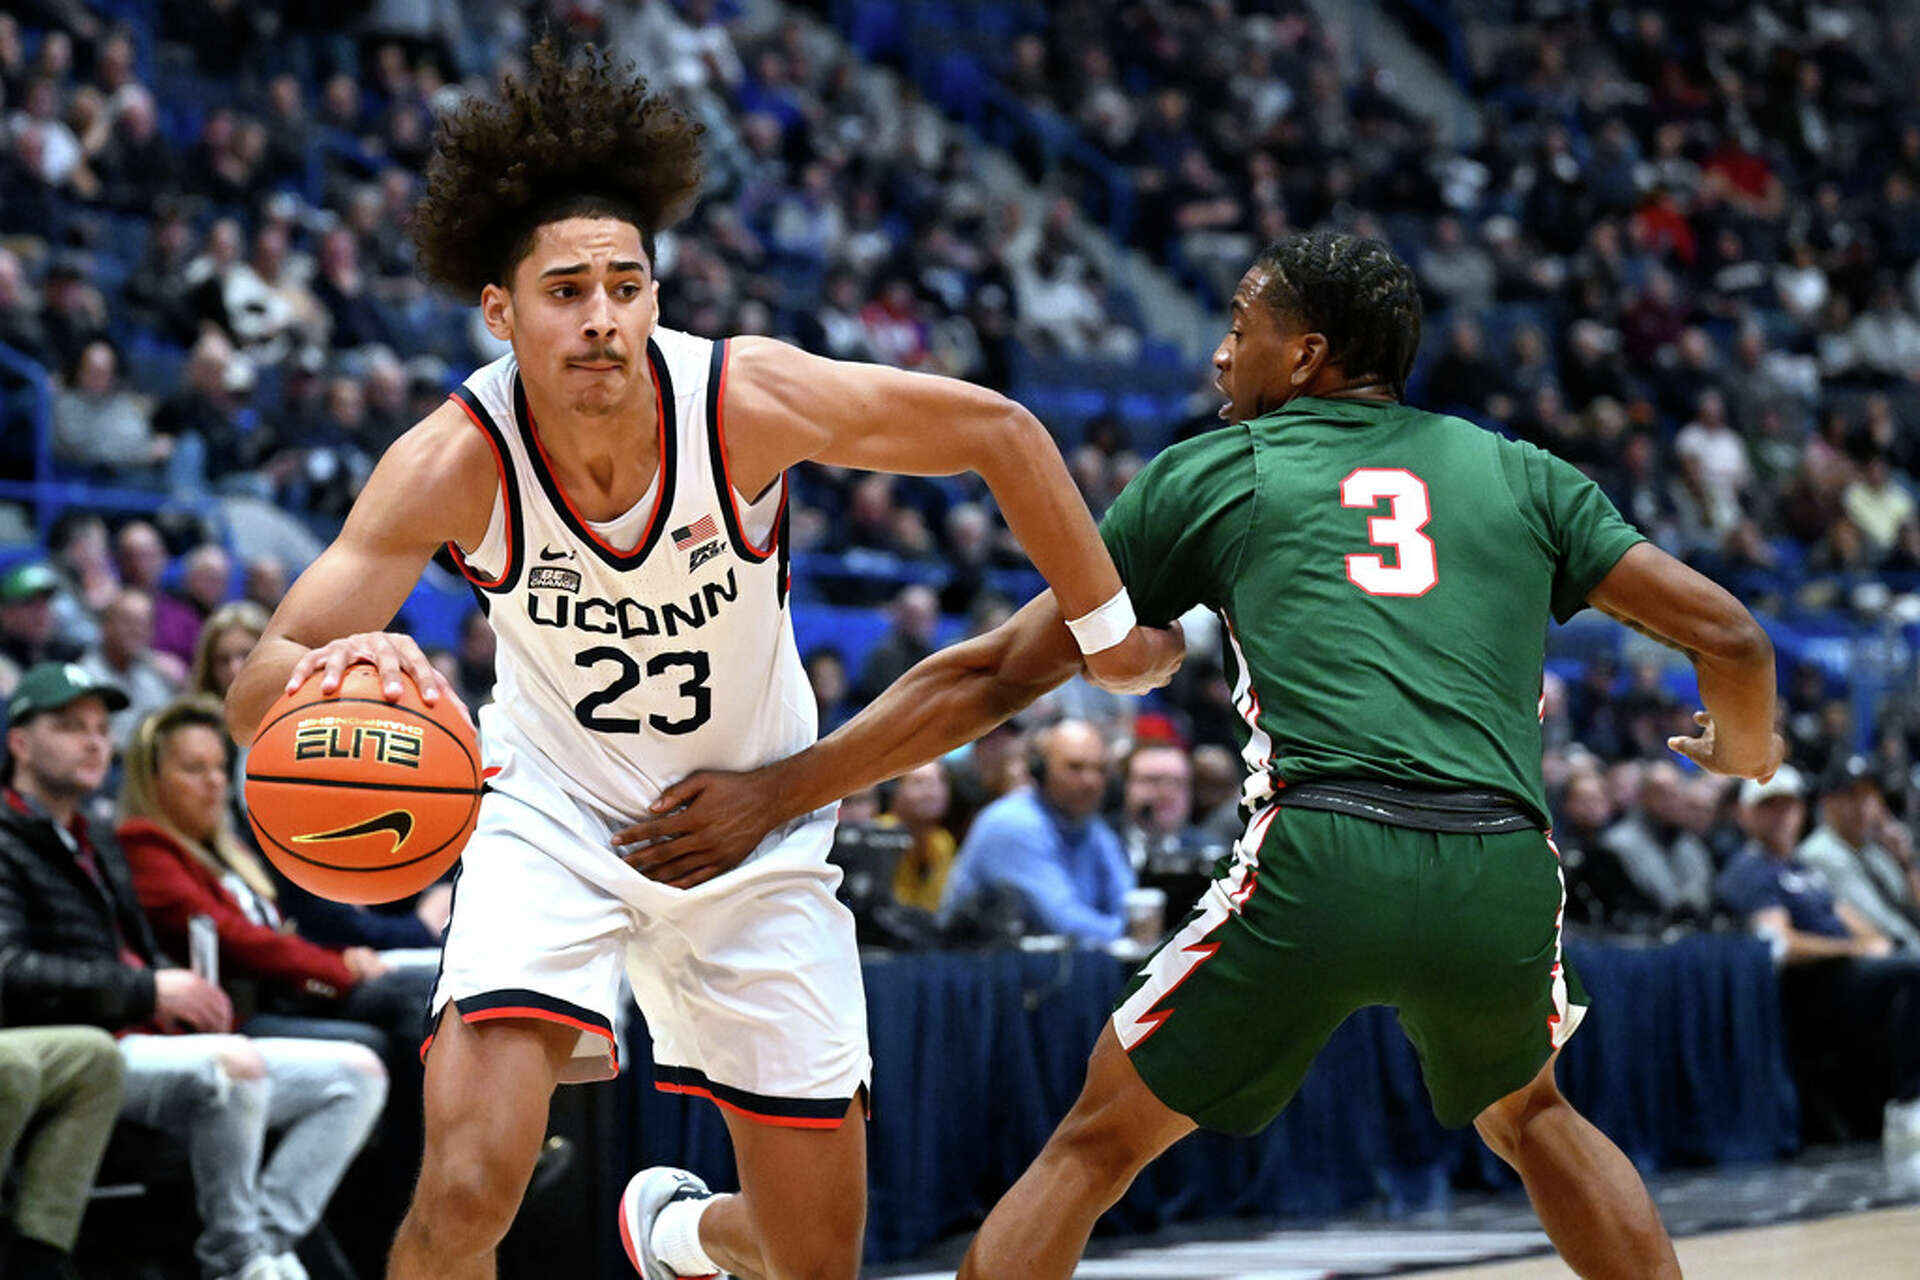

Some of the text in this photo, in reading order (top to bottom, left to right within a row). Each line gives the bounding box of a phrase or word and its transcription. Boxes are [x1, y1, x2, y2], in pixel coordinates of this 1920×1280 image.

[1339, 467, 1439, 597] 3
[528, 567, 737, 639] UCONN
[575, 646, 711, 735] 23
[295, 726, 423, 769] ELITE
